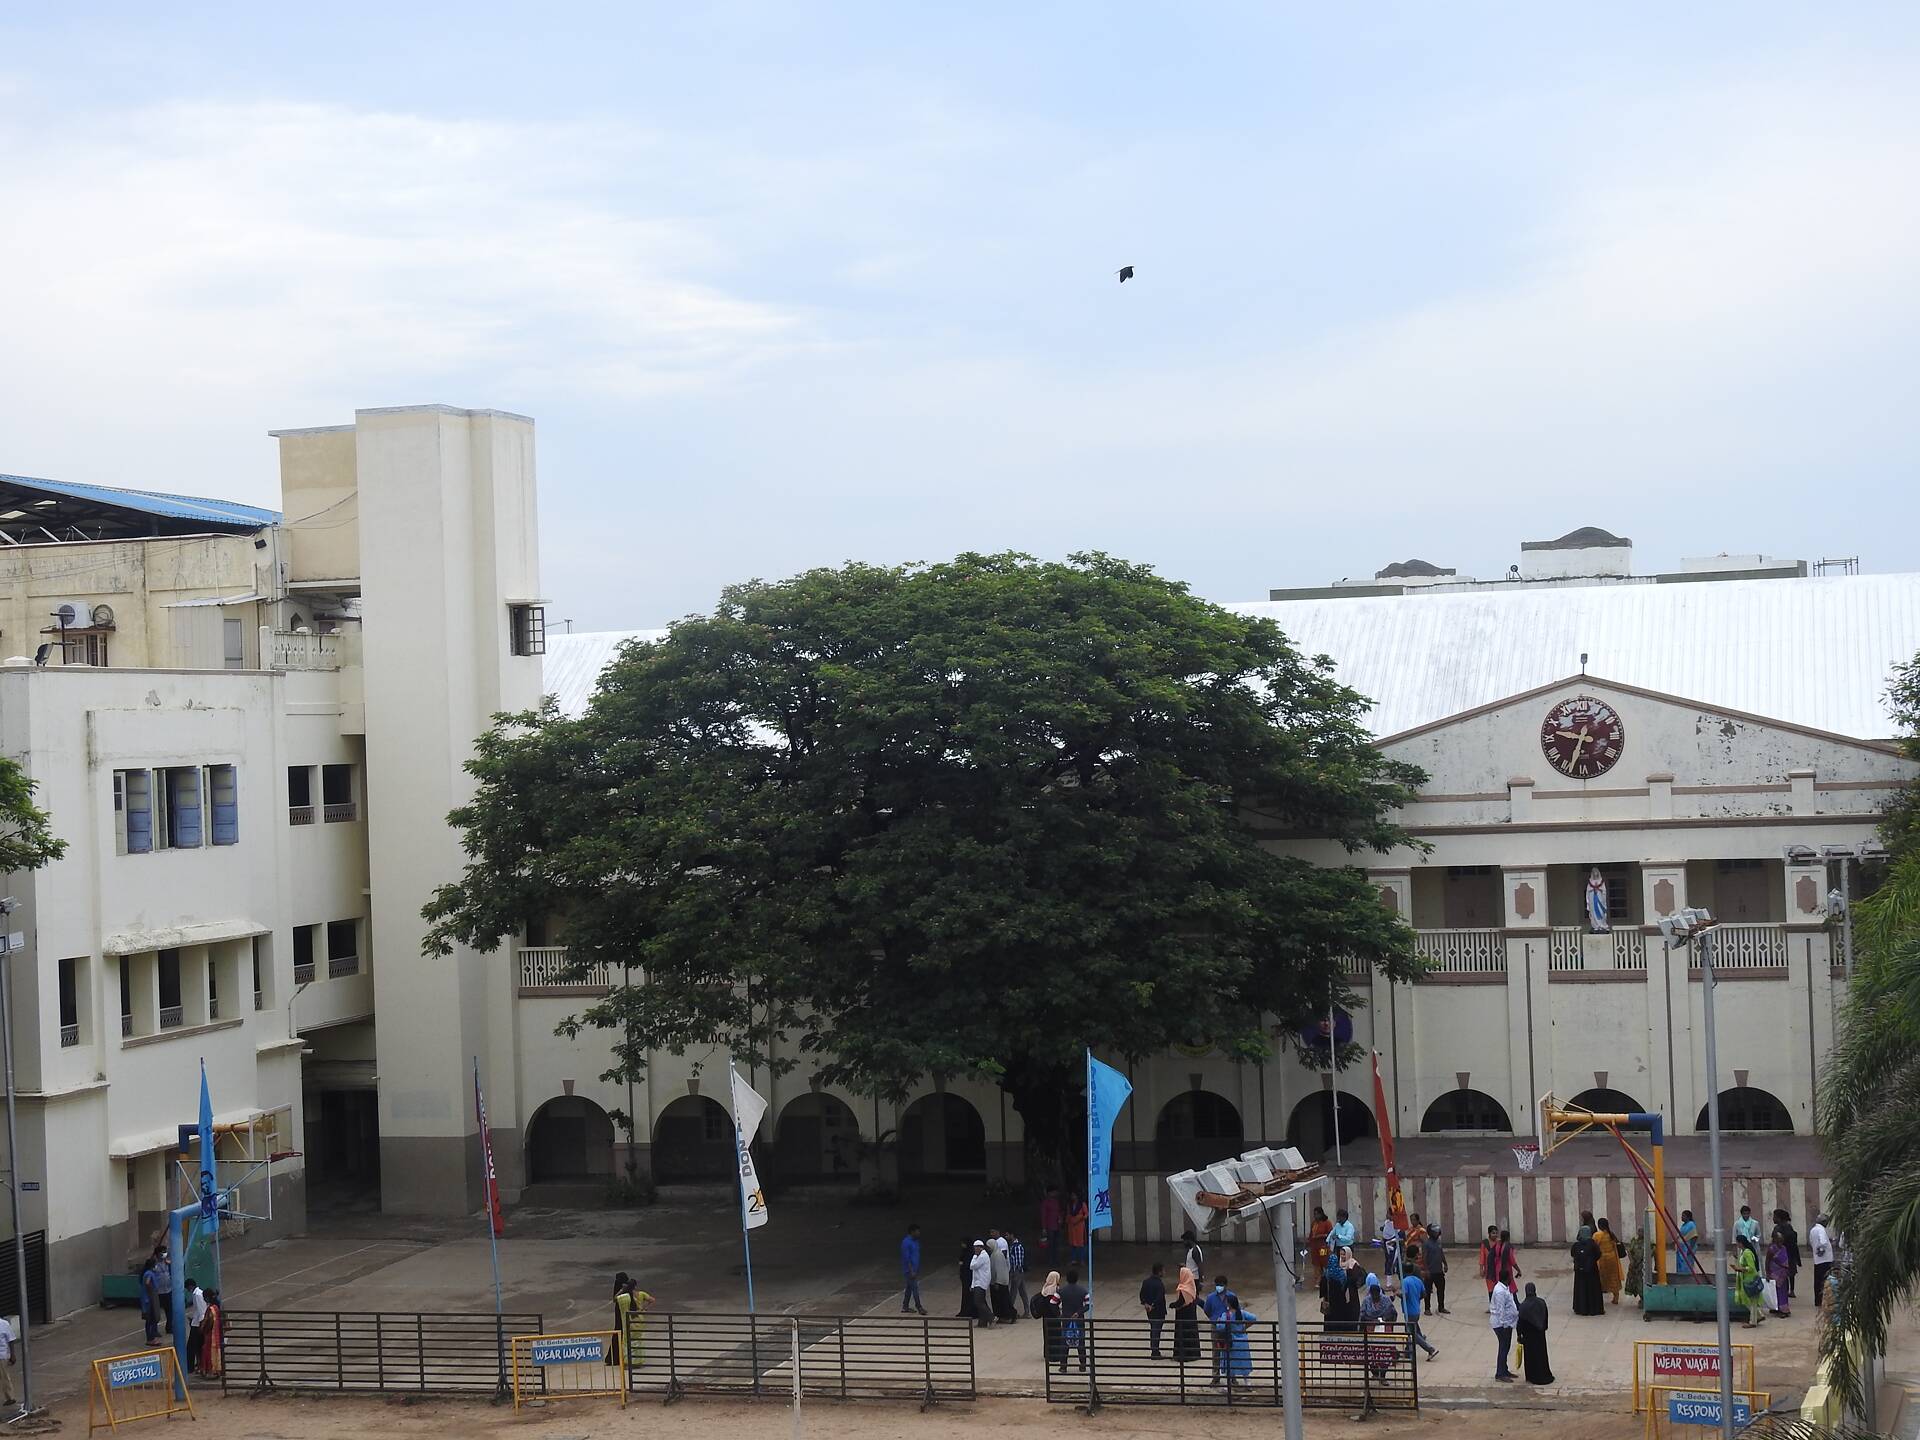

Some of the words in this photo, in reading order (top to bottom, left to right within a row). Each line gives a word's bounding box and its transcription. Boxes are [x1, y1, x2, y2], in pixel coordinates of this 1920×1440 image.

[535, 1349, 561, 1361] WEAR
[563, 1347, 586, 1361] WASH
[586, 1346, 602, 1358] AIR
[1656, 1356, 1682, 1370] WEAR
[1684, 1358, 1709, 1372] WASH
[112, 1366, 156, 1382] RESPECTFUL
